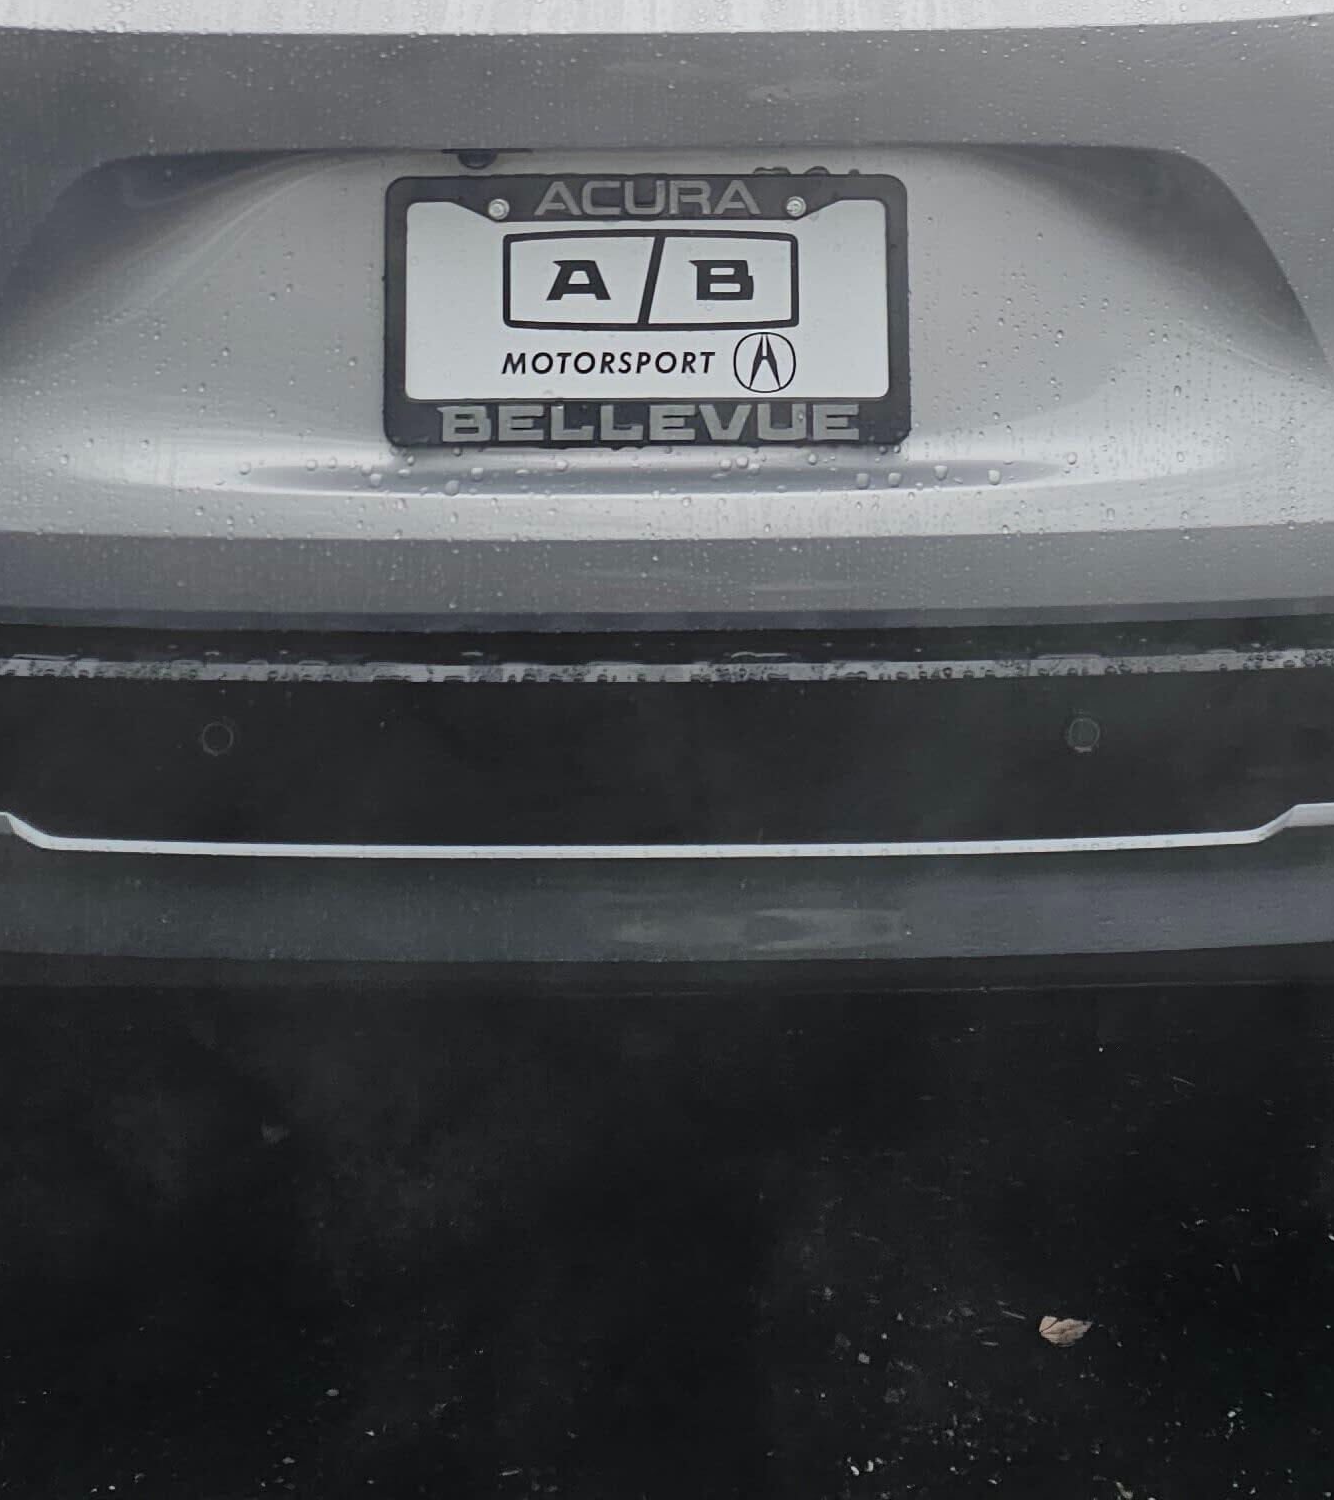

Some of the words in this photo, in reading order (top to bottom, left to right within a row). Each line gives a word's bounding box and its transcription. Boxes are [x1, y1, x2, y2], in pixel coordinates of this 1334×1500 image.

[532, 179, 762, 217] ACURA
[500, 350, 717, 376] MOTORSPORT
[437, 402, 861, 443] BELLEVUE
